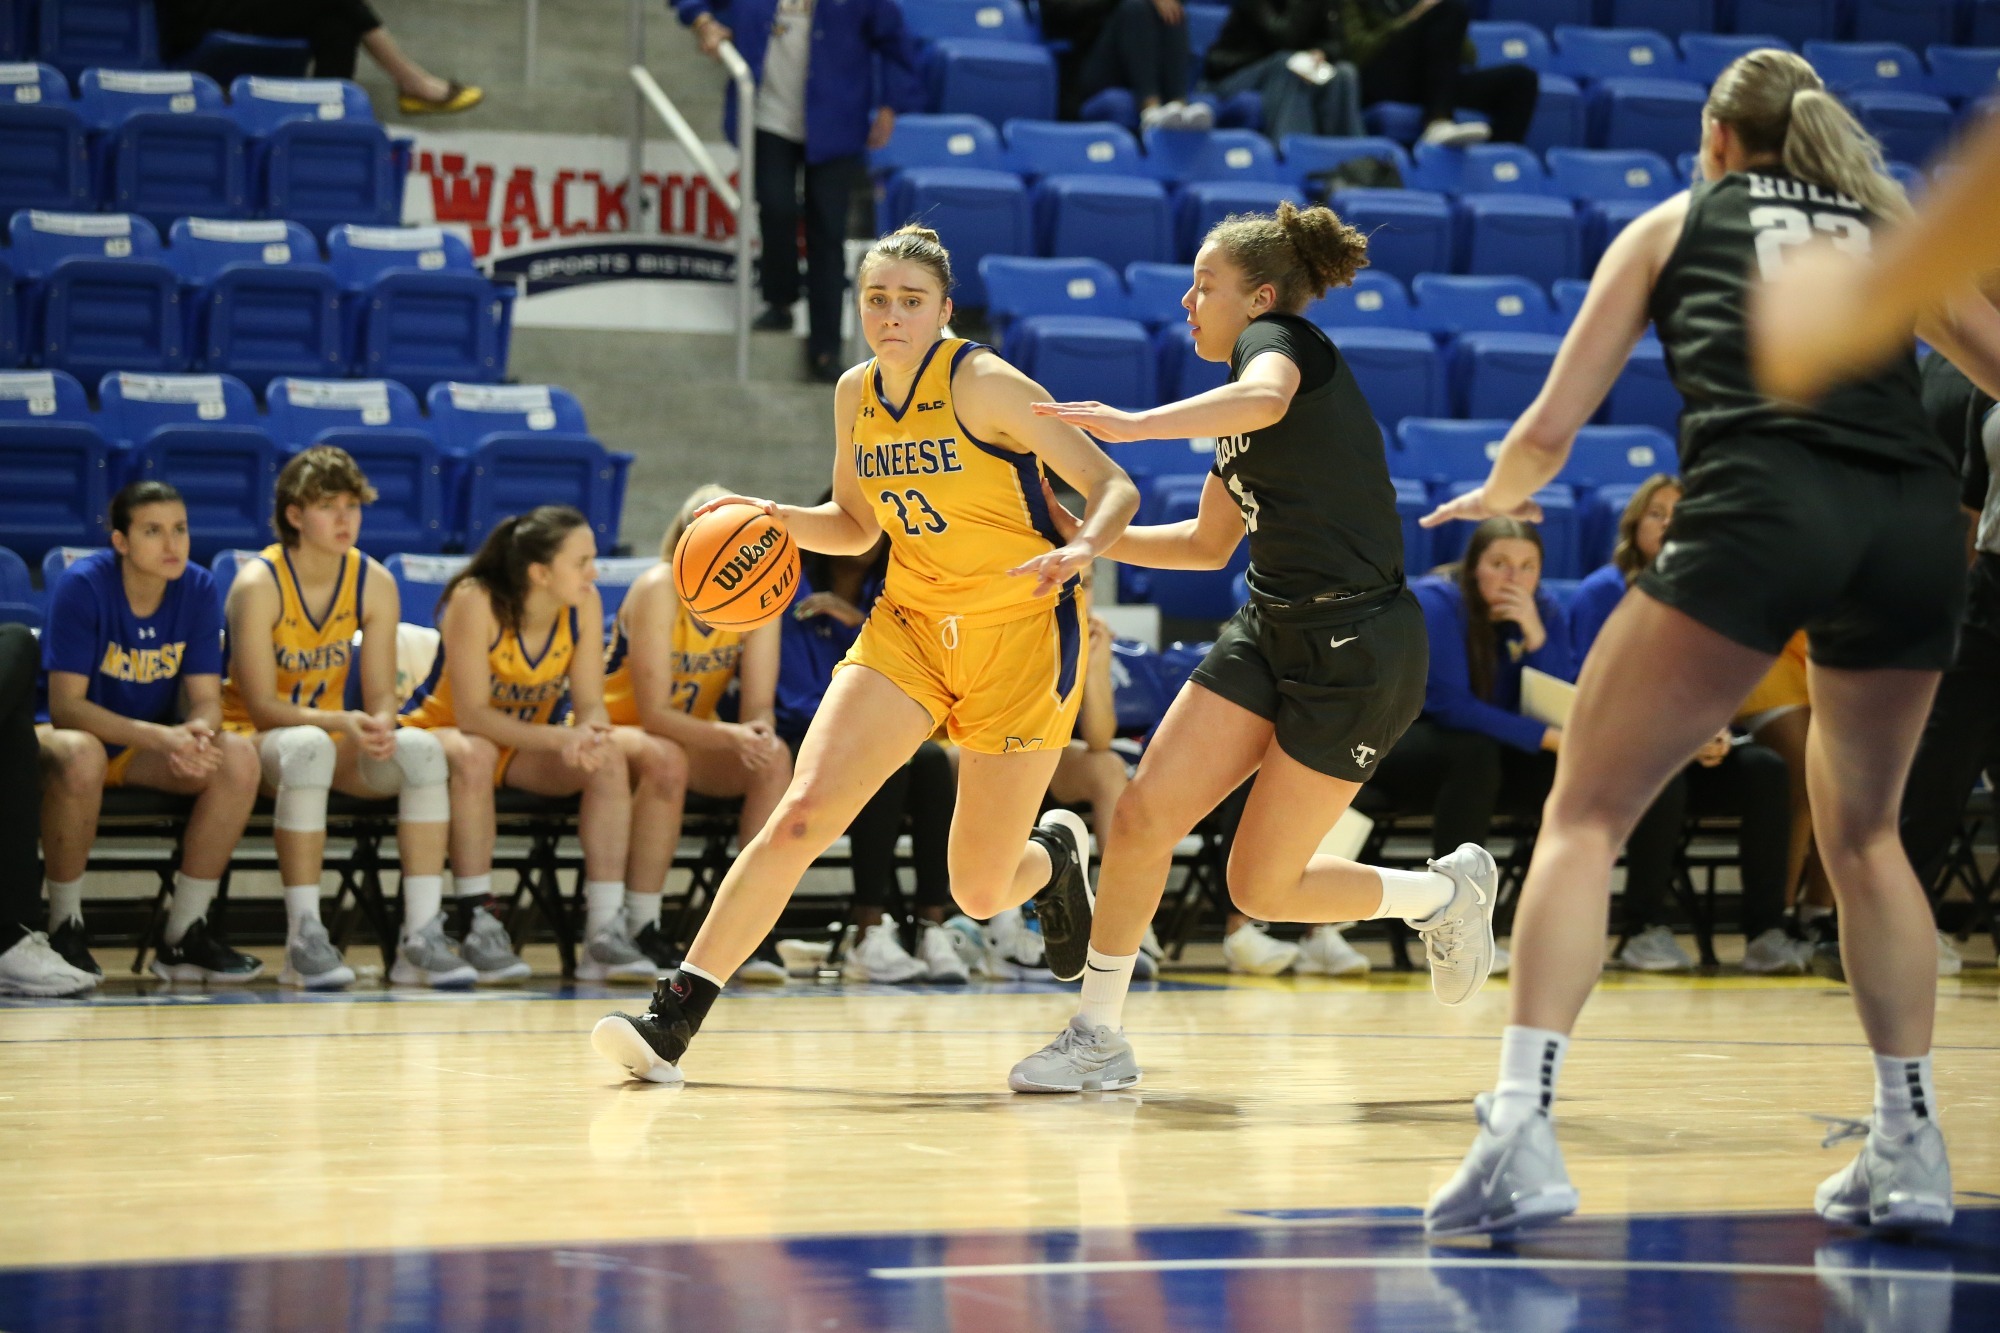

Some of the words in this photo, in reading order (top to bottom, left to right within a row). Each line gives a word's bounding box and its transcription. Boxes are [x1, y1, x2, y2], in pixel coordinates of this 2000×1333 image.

[528, 252, 632, 281] SPORTS
[853, 437, 963, 478] McNEESE
[879, 488, 949, 536] 23
[711, 525, 783, 591] Wilson
